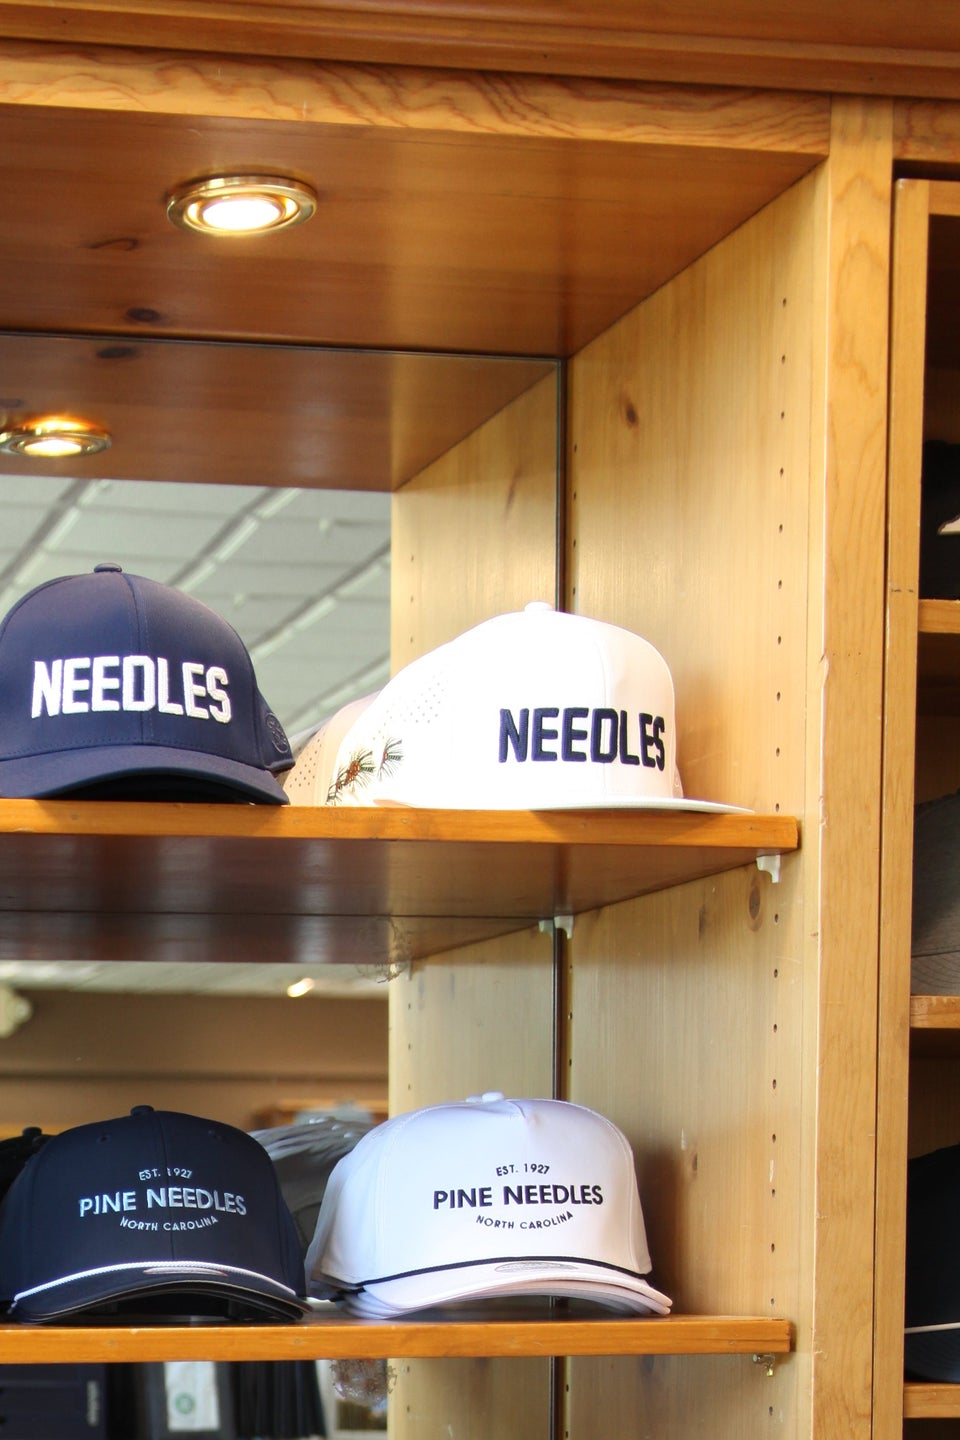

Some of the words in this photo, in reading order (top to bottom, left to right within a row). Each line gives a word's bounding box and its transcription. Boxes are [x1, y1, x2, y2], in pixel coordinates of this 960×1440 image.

[31, 655, 232, 724] NEEDLES
[498, 707, 665, 771] NEEDLES
[139, 1168, 161, 1181] EST.
[166, 1167, 192, 1180] 1927
[496, 1165, 518, 1177] EST.
[524, 1163, 550, 1175] 1927
[79, 1191, 137, 1217] PINE
[146, 1187, 247, 1216] NEEDLES
[433, 1187, 493, 1210] PINE
[503, 1184, 603, 1205] NEEDLES
[120, 1216, 158, 1231] NORTH
[163, 1215, 219, 1231] CAROLINA
[476, 1214, 514, 1229] NORTH
[519, 1211, 574, 1230] CAROLINA
